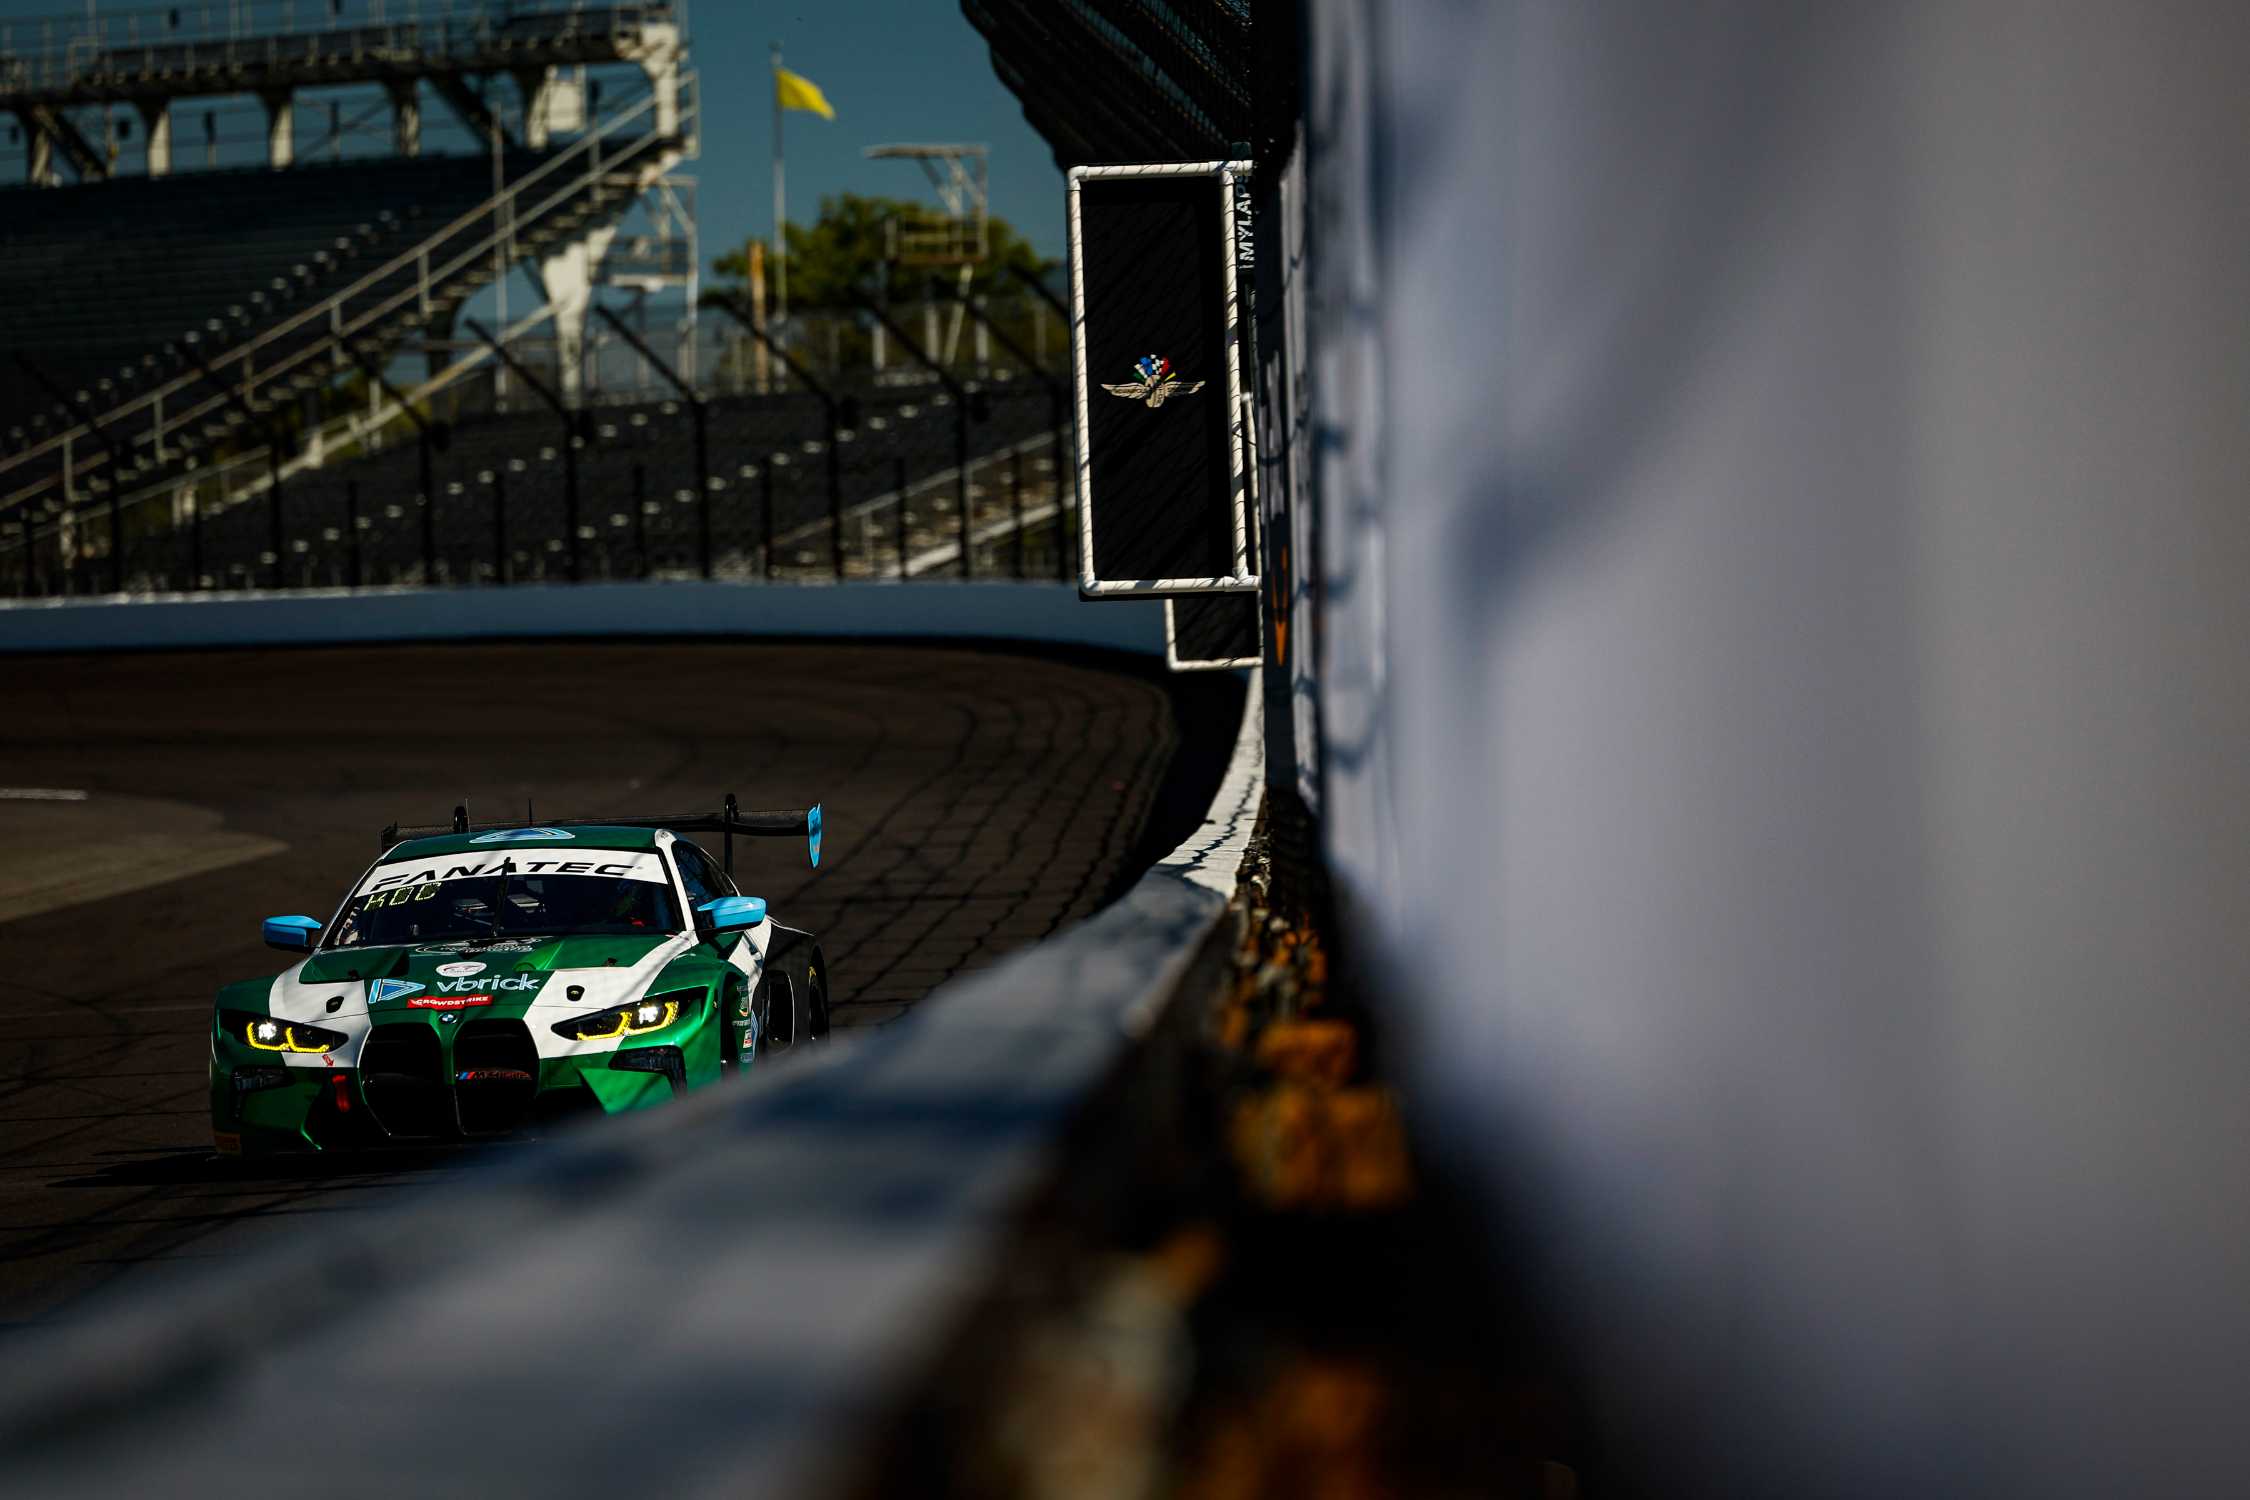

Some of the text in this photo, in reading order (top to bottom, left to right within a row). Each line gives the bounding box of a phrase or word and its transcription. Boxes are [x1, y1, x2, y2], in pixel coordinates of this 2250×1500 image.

[371, 861, 634, 891] FANATEC
[436, 973, 541, 993] vbrick
[415, 996, 489, 1006] CROWDSTRIKE
